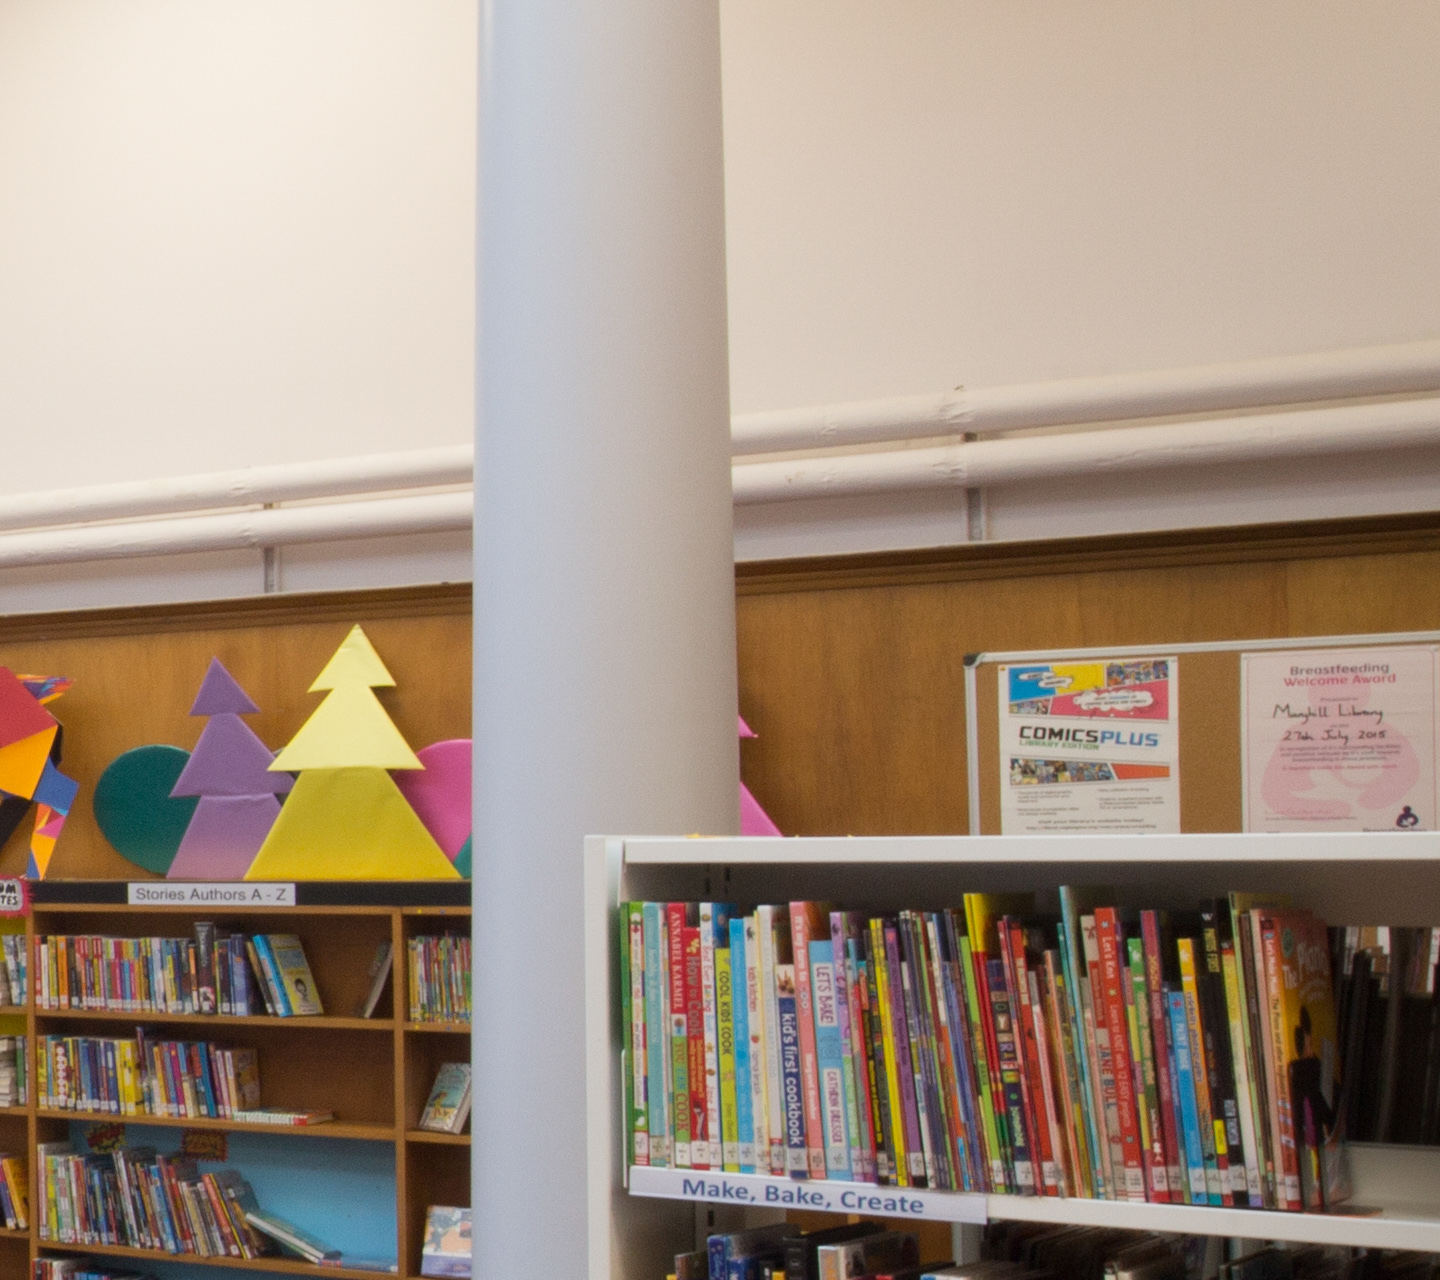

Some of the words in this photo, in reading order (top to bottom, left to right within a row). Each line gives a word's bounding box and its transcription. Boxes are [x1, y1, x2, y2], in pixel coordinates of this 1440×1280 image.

[1283, 674, 1347, 687] Welcome
[1349, 674, 1396, 685] Award
[1290, 662, 1390, 677] Breastfeeding
[1019, 725, 1159, 747] COMICSPLUS
[1019, 740, 1059, 750] LIBRARY
[1061, 741, 1100, 751] EDITION
[1321, 728, 1351, 744] July
[136, 888, 185, 901] Stories
[190, 888, 246, 901] Authors
[251, 889, 263, 901] A
[276, 889, 287, 901] Z
[669, 911, 682, 962] ANNABEL
[1101, 936, 1115, 959] Let's
[685, 956, 699, 987] How
[718, 970, 729, 1000] COOL
[816, 965, 831, 994] LET'S
[671, 964, 684, 1010] KARMEL
[687, 999, 702, 1037] Cook
[720, 1002, 731, 1025] KIDS
[782, 1012, 795, 1044] kid's
[721, 1026, 732, 1056] COOK
[784, 1046, 797, 1073] first
[1098, 1043, 1114, 1077] JANE
[1102, 1078, 1118, 1109] BULL
[675, 1092, 690, 1132] COOK
[785, 1076, 802, 1145] cookbook
[829, 1109, 843, 1144] DRESSER
[682, 1179, 755, 1203] Make,
[765, 1185, 831, 1210] Bake,
[840, 1191, 924, 1214] Create
